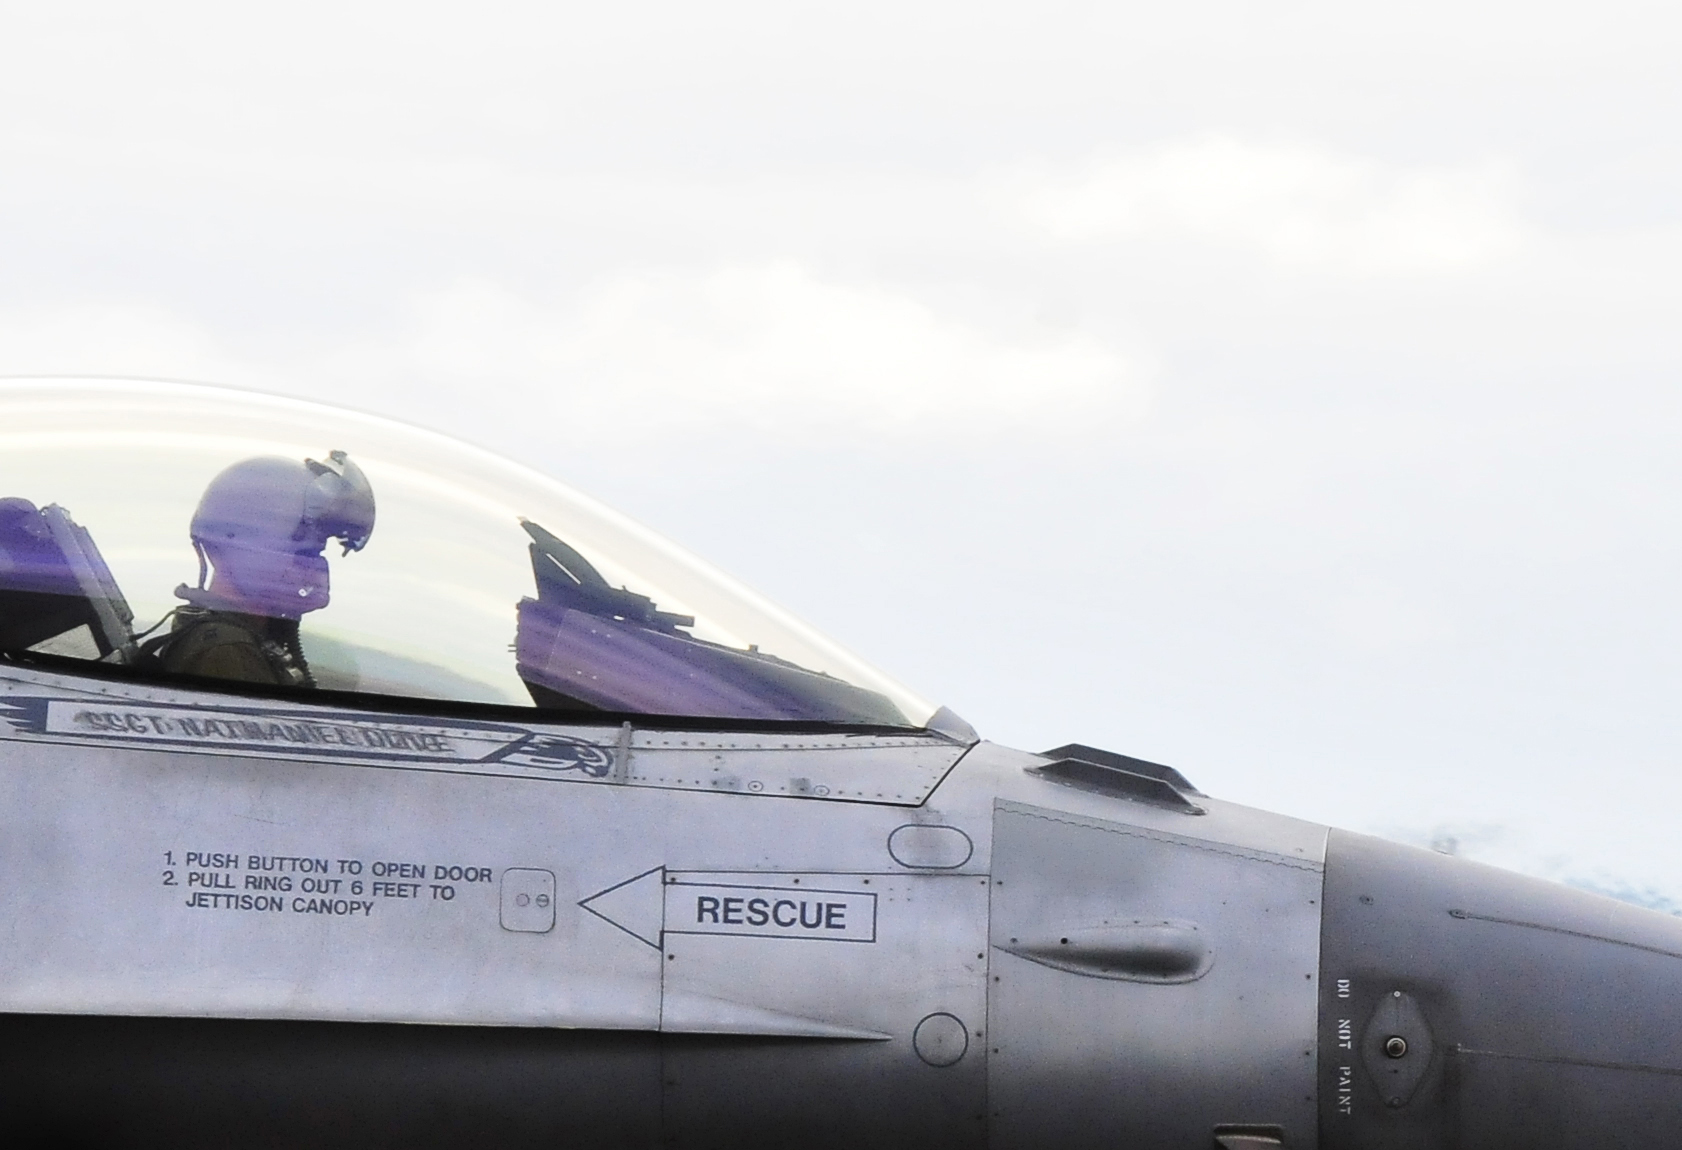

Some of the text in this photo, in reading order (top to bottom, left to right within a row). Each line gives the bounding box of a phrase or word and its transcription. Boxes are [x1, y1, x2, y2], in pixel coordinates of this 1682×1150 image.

[163, 850, 492, 883] 1. PUSH BUTTON TO OPEN DOOR
[162, 870, 455, 901] 2. PULL RING OUT 6 FEET TO
[185, 891, 374, 917] JETTISON CANOPY
[696, 896, 847, 930] RESCUE
[1337, 979, 1351, 1114] DO NOT PAINT
